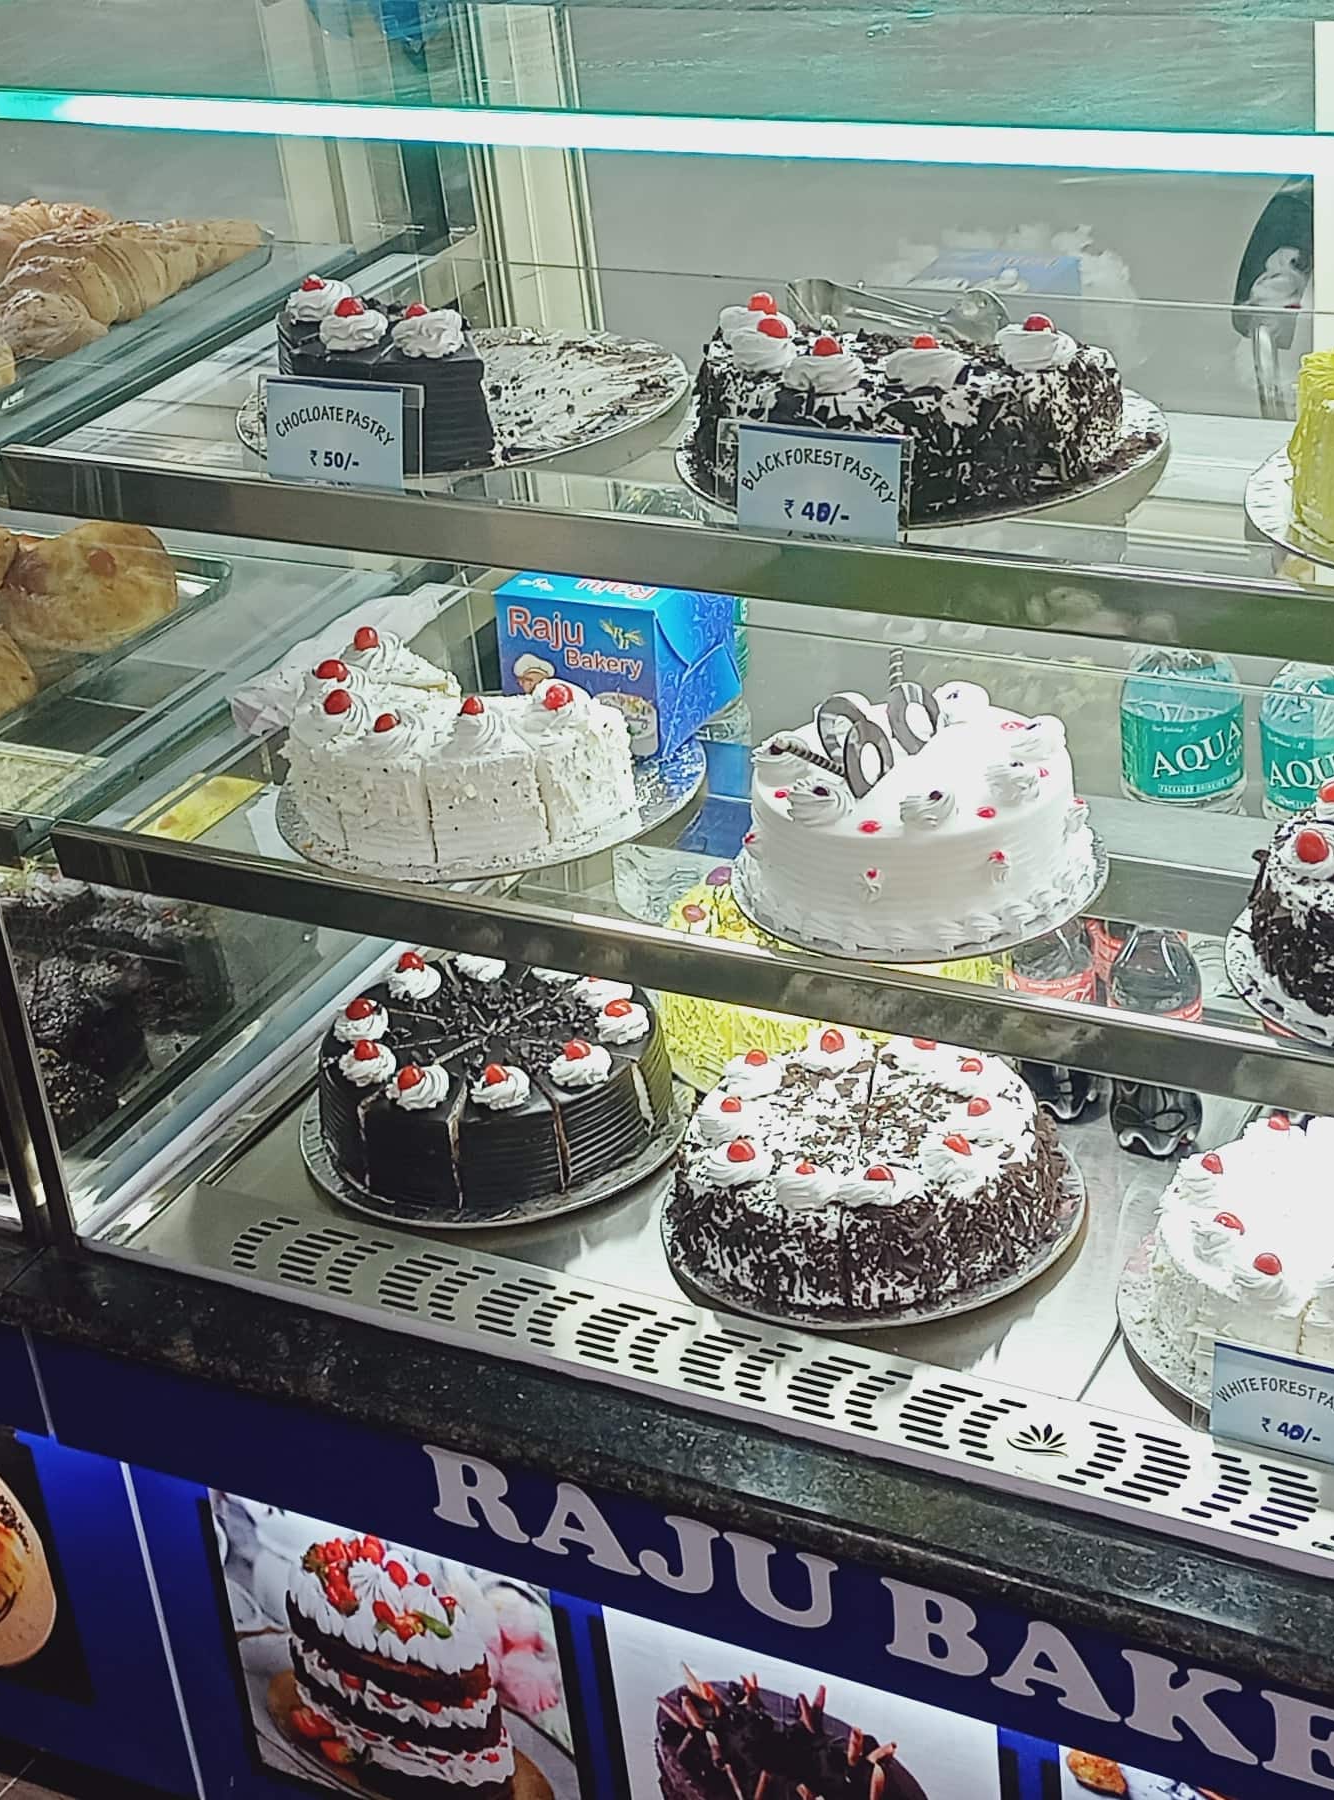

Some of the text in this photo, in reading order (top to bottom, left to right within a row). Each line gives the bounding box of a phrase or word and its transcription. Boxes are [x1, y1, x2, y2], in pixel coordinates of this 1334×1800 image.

[275, 405, 395, 446] CHOCLOATE PASTRY
[741, 452, 785, 491] BLACK
[842, 455, 897, 504] PASTRY
[507, 606, 585, 650] Raju
[564, 648, 643, 681] Bakery
[1151, 720, 1244, 779] AQUA
[422, 1444, 839, 1628] RAJU
